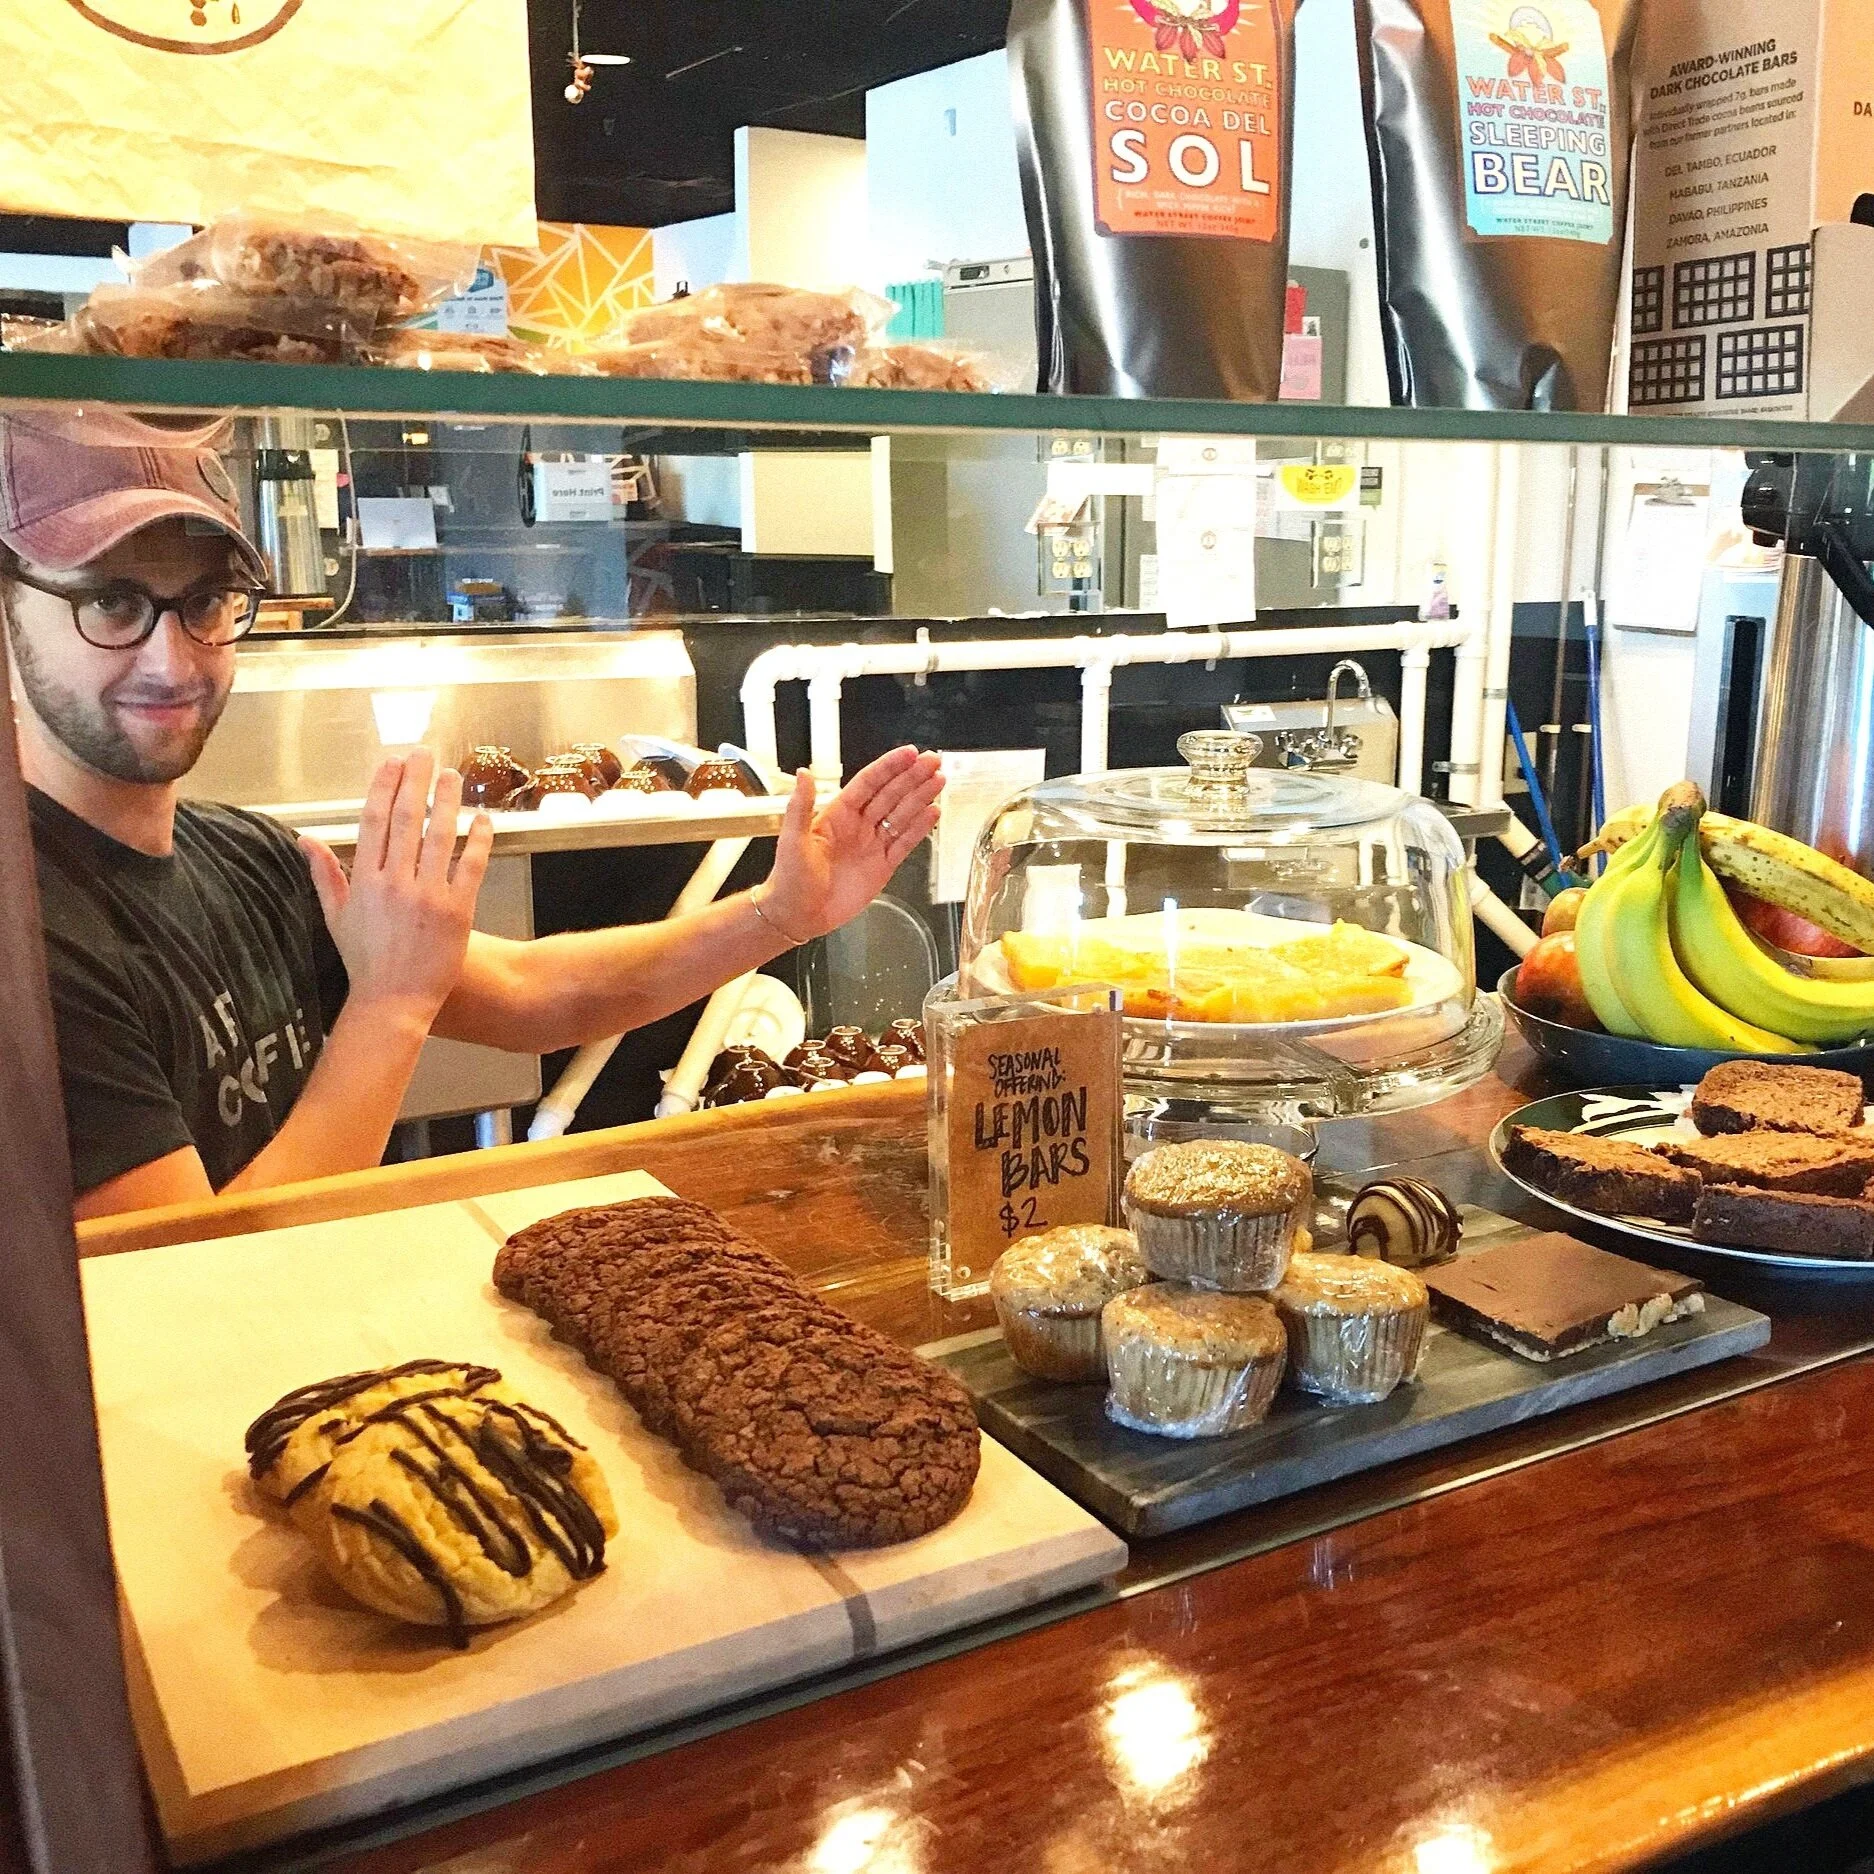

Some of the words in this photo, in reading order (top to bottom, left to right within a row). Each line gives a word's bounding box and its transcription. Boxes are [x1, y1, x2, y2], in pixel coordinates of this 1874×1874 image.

[1103, 47, 1222, 81] WATER
[1232, 62, 1273, 90] ST.
[1650, 79, 1682, 99] DARK
[1684, 61, 1760, 91] CHOCOLATE
[1762, 51, 1798, 72] BARS
[1668, 38, 1776, 78] AWARD-WINNING
[1103, 77, 1147, 94] HOT
[1155, 82, 1272, 110] CHOCOLATE
[1465, 75, 1566, 105] WATER
[1572, 86, 1606, 114] ST.
[1749, 86, 1769, 98] bars
[1770, 77, 1797, 93] made
[1104, 100, 1212, 128] COCOA
[1222, 110, 1272, 136] DEL
[1467, 102, 1505, 117] HOT
[1508, 105, 1605, 129] CHOCOLATE
[1661, 119, 1687, 133] Direct
[1739, 101, 1765, 116] beans
[1767, 90, 1804, 109] sourced
[1713, 120, 1749, 137] partners
[1751, 109, 1785, 128] located
[1469, 121, 1606, 157] SLEEPING
[1109, 128, 1271, 196] SOL
[1471, 150, 1611, 206] BEAR
[1664, 164, 1683, 178] DEL
[1686, 156, 1723, 173] TAMBO,
[1725, 145, 1777, 165] ECUADOR
[1717, 172, 1769, 191] TANZANIA
[1706, 197, 1769, 218] PHILIPPINES
[1713, 223, 1769, 241] AMAZONIA
[988, 1047, 1060, 1080] SEASONAL
[994, 1068, 1066, 1098] OFFERING:
[974, 1086, 1088, 1150] LEMON
[1001, 1137, 1090, 1198] BARS
[1000, 1196, 1048, 1238] $2
